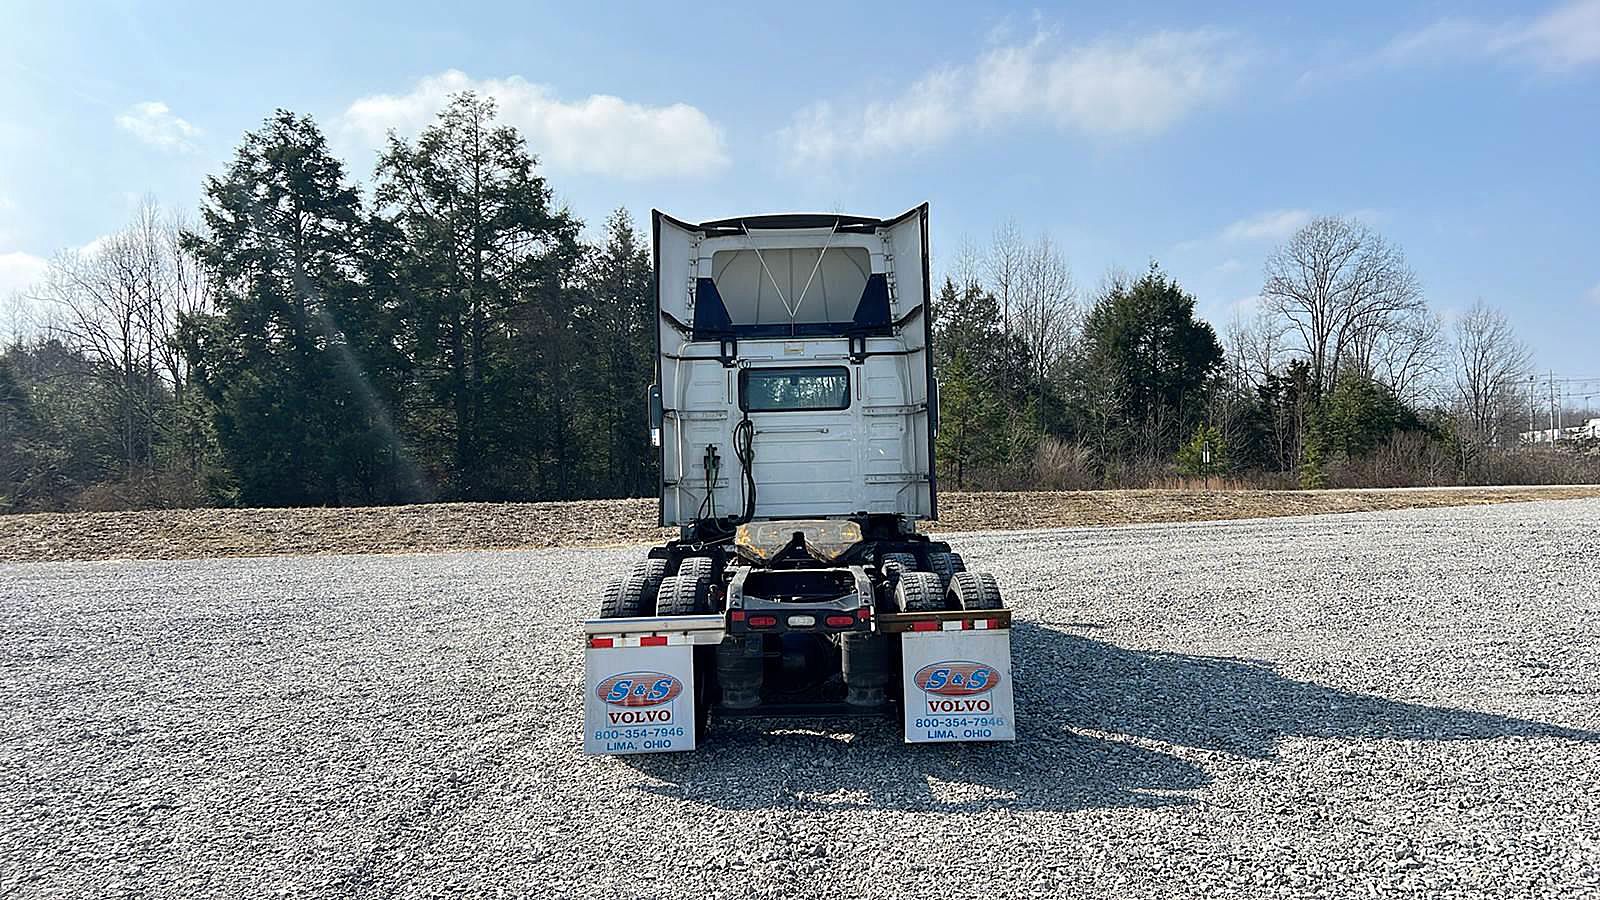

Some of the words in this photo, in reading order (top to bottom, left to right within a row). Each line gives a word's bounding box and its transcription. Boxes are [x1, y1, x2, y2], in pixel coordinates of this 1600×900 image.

[928, 700, 990, 712] VOLVO
[609, 710, 671, 724] VOLVO
[915, 717, 1004, 728] 800-354-7946
[595, 727, 684, 740] 800-354-7946
[963, 729, 992, 738] OHIO
[643, 740, 672, 749] OHIO
